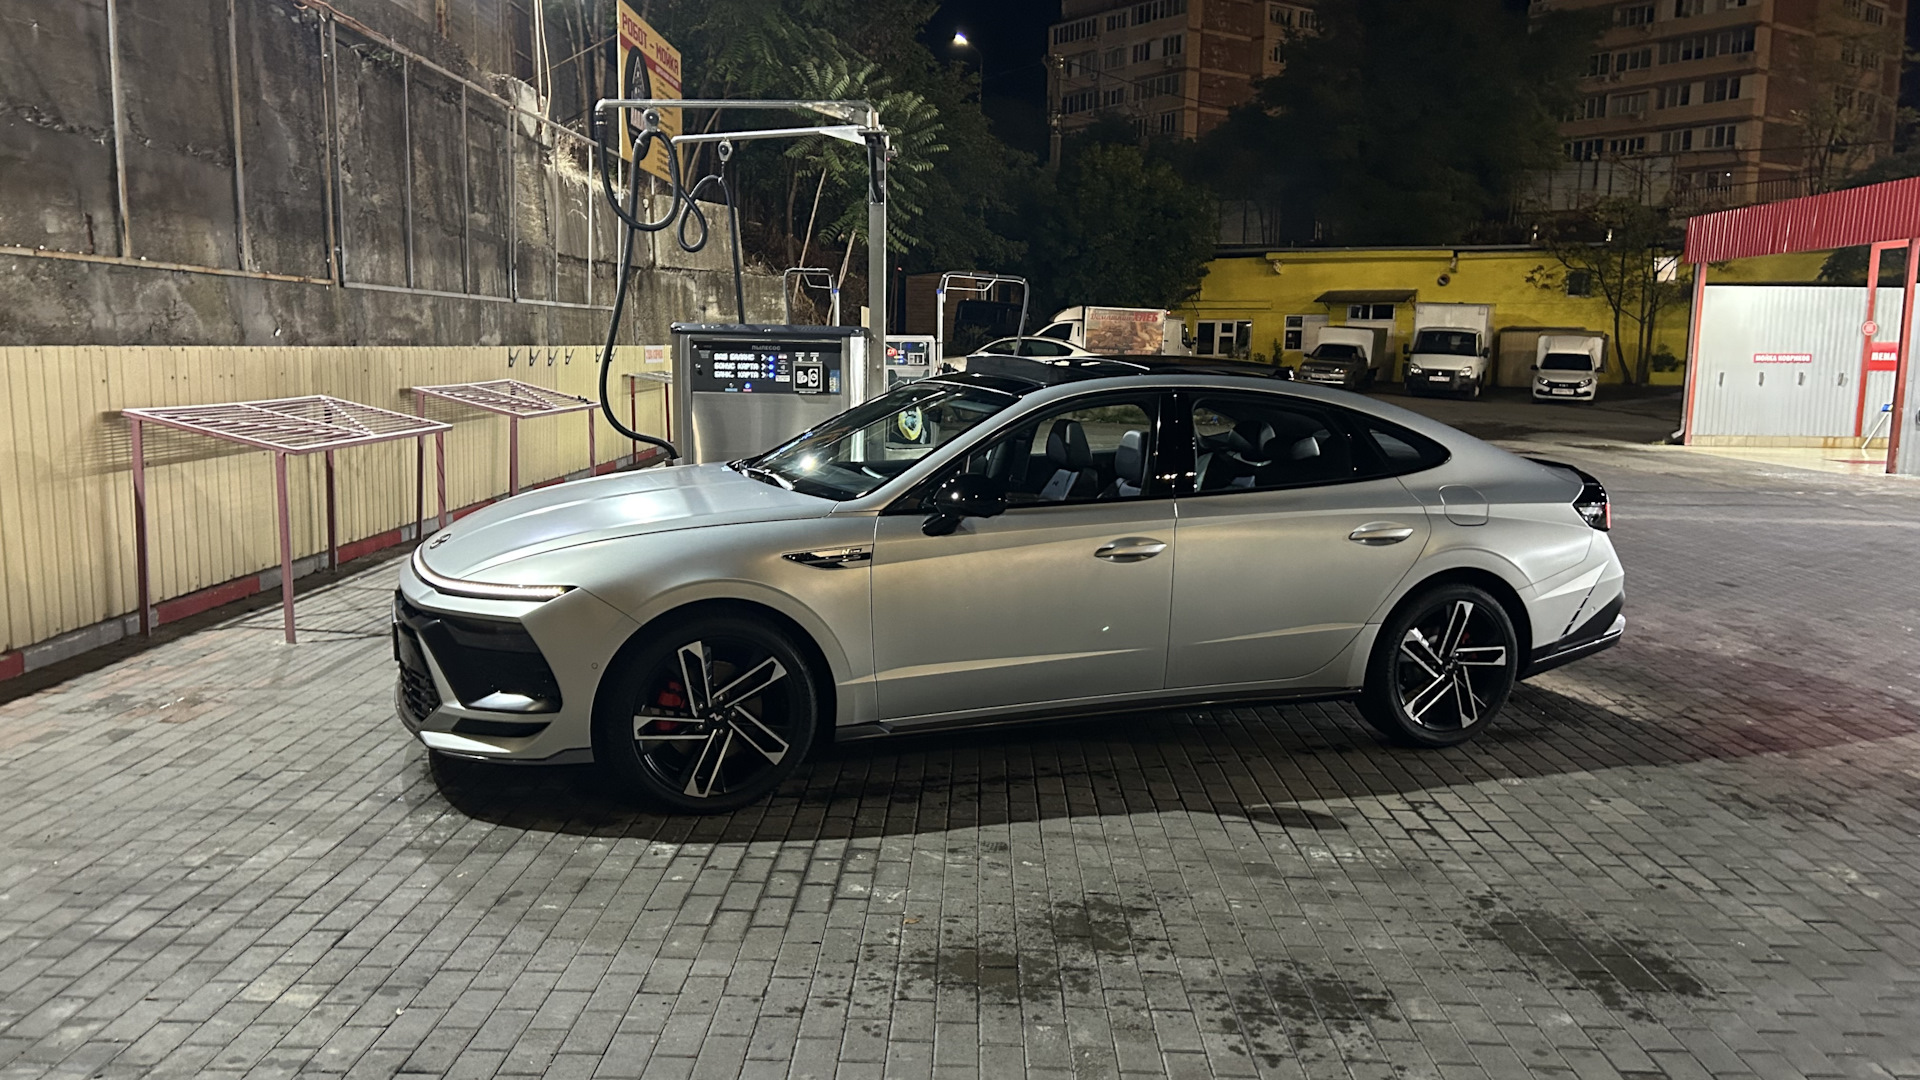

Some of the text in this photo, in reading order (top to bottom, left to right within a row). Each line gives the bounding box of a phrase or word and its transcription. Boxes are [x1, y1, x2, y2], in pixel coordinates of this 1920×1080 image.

[622, 12, 647, 49] РОБОТ
[1133, 312, 1158, 322] ХЛЕБ
[1755, 354, 1777, 362] МОЙКА
[1871, 352, 1897, 361] ПЕНА
[714, 362, 736, 370] БОНУС
